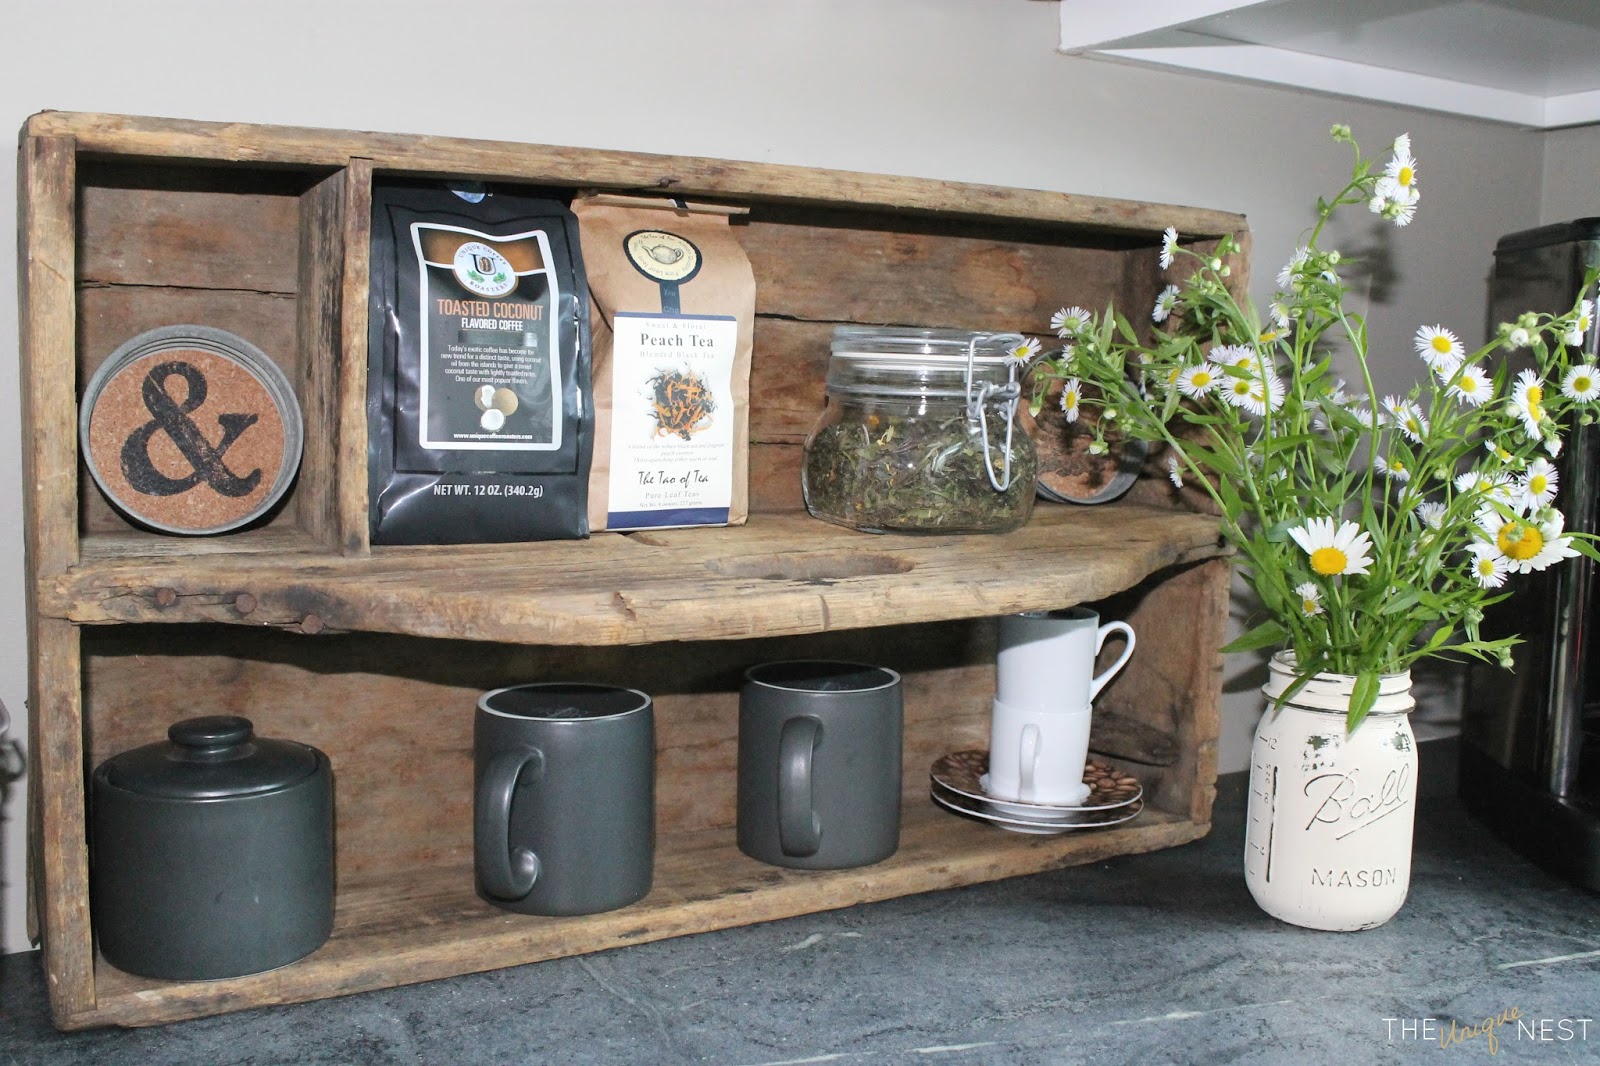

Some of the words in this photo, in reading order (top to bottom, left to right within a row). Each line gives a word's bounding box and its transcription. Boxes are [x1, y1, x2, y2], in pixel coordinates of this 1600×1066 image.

[458, 246, 480, 258] UNIQUE
[482, 247, 506, 265] COFFEE
[470, 281, 507, 292] ROASTERS
[437, 299, 490, 317] TOASTED
[494, 302, 544, 320] COCONUT
[461, 318, 497, 330] FLAVORED
[498, 320, 523, 331] COFFEE
[683, 322, 706, 330] Floral
[640, 333, 683, 346] Peach
[689, 335, 714, 347] Tea
[448, 345, 467, 353] Today's
[120, 360, 261, 498] &
[454, 432, 533, 440] www.uniquecoffeeroasters.com
[638, 470, 654, 484] The
[658, 470, 676, 484] Tao
[680, 470, 690, 488] of
[694, 470, 709, 482] Tea
[434, 485, 452, 495] NET
[454, 485, 471, 496] WT.
[474, 485, 485, 495] 12
[487, 485, 502, 496] OZ.
[504, 485, 543, 498] (340.2g)
[1304, 763, 1409, 830] Ball
[1312, 868, 1396, 888] MASON
